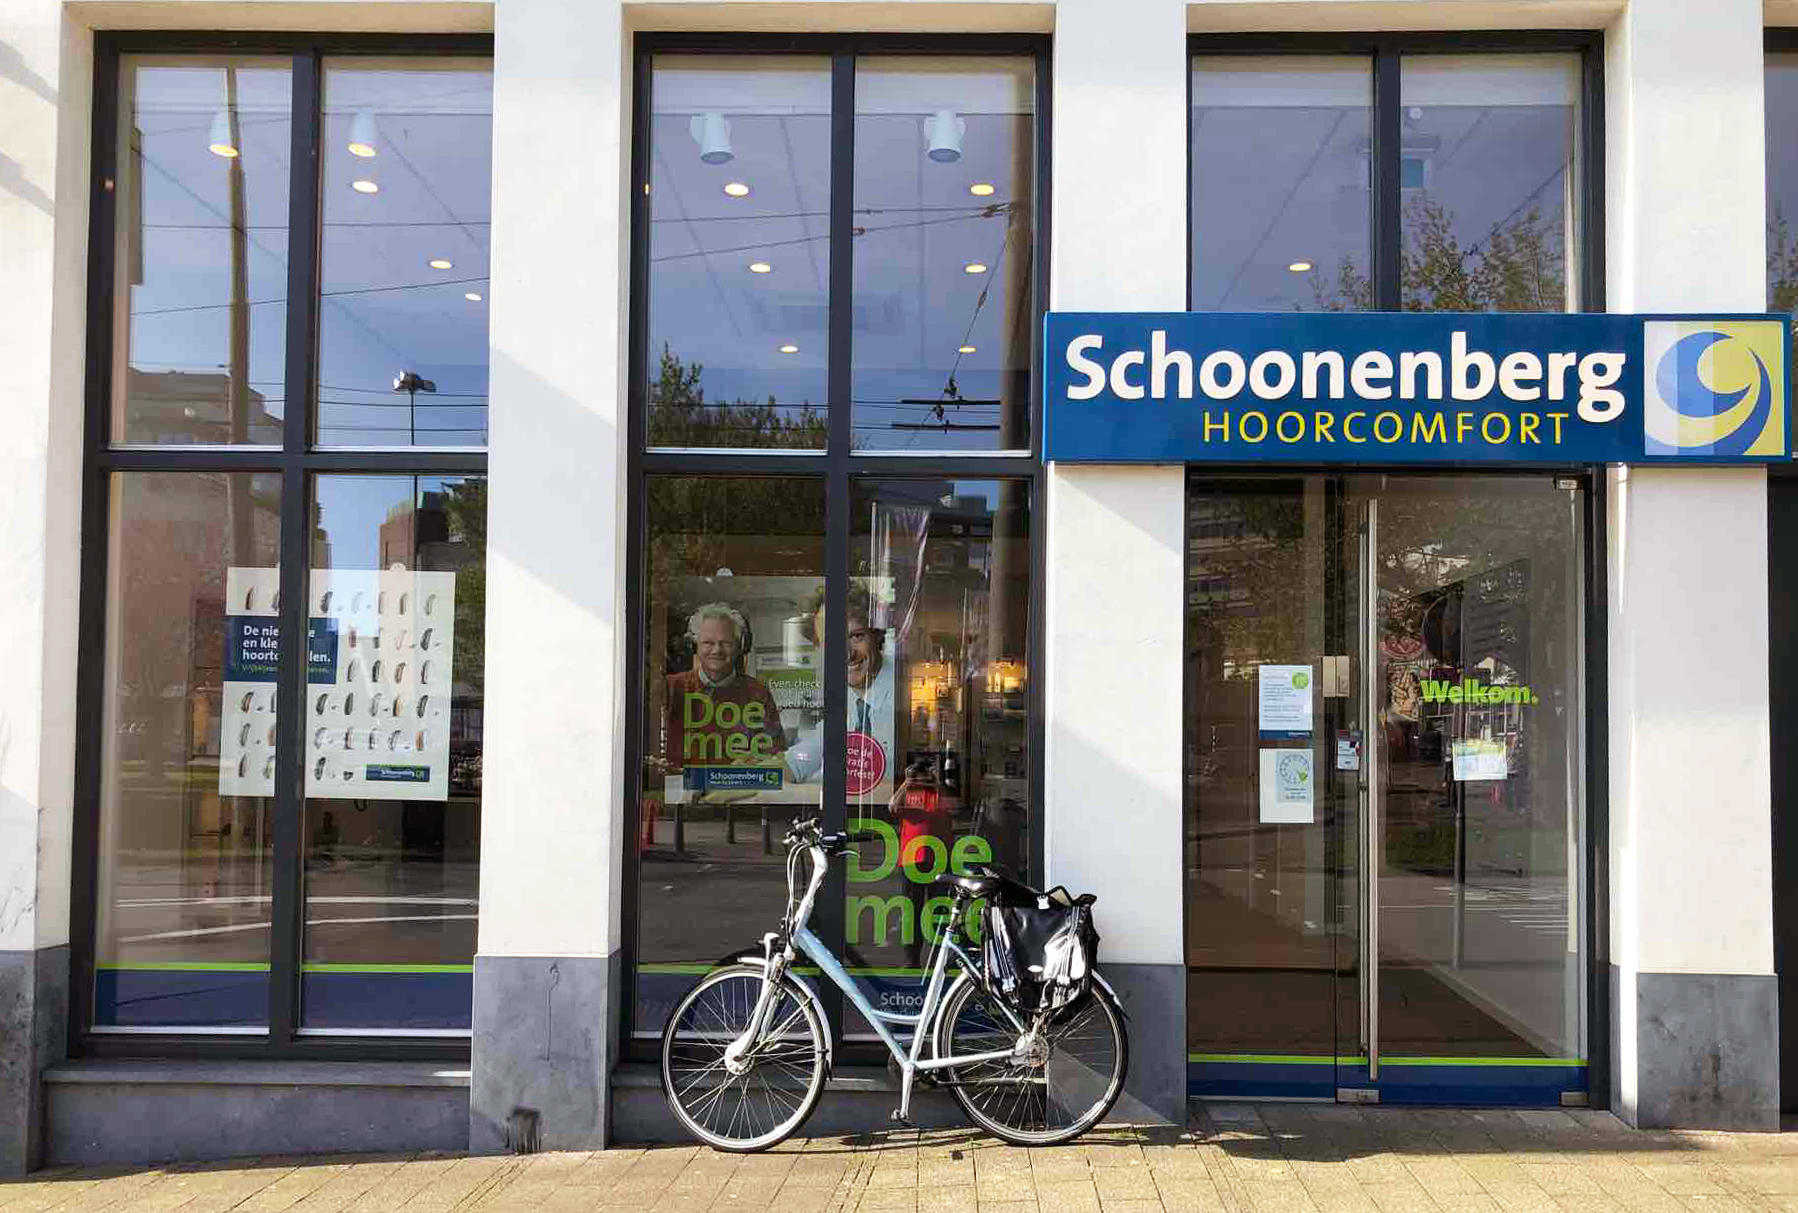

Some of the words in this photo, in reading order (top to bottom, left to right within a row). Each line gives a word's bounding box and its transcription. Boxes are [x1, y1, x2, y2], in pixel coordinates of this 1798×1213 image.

[1065, 329, 1627, 424] Schoonenberg
[1203, 411, 1571, 446] HOORCOMFORT
[243, 625, 259, 636] De
[243, 639, 257, 648] en
[1420, 678, 1539, 704] Welkom.
[684, 692, 765, 729] Doe
[684, 733, 773, 760] mee
[847, 818, 992, 884] Doe
